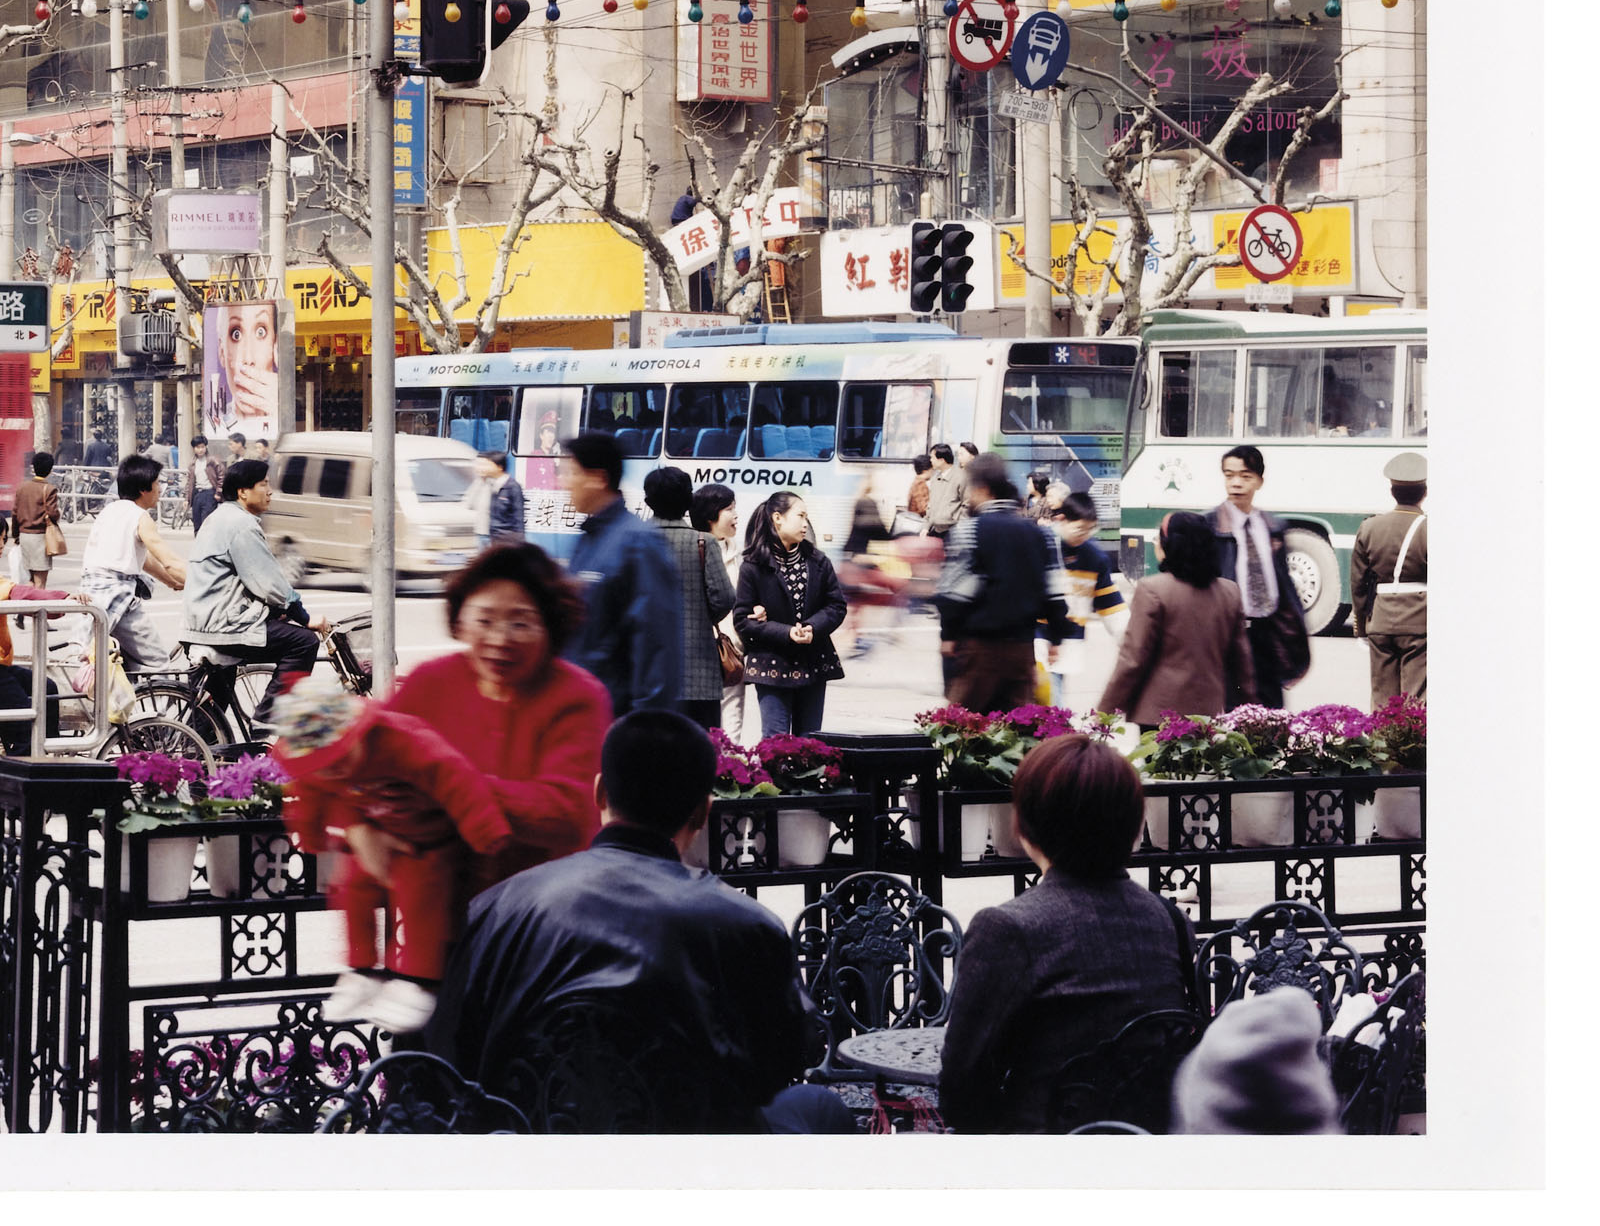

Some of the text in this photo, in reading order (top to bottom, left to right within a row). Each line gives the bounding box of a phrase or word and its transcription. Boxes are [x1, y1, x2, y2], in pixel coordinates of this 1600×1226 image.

[171, 212, 223, 223] RIMMEL
[1288, 258, 1341, 275] 速彩色
[15, 331, 26, 341] 北
[428, 363, 491, 375] MOTOROLA
[628, 358, 701, 371] MOTOROLA
[693, 467, 814, 487] MOTOROLA
